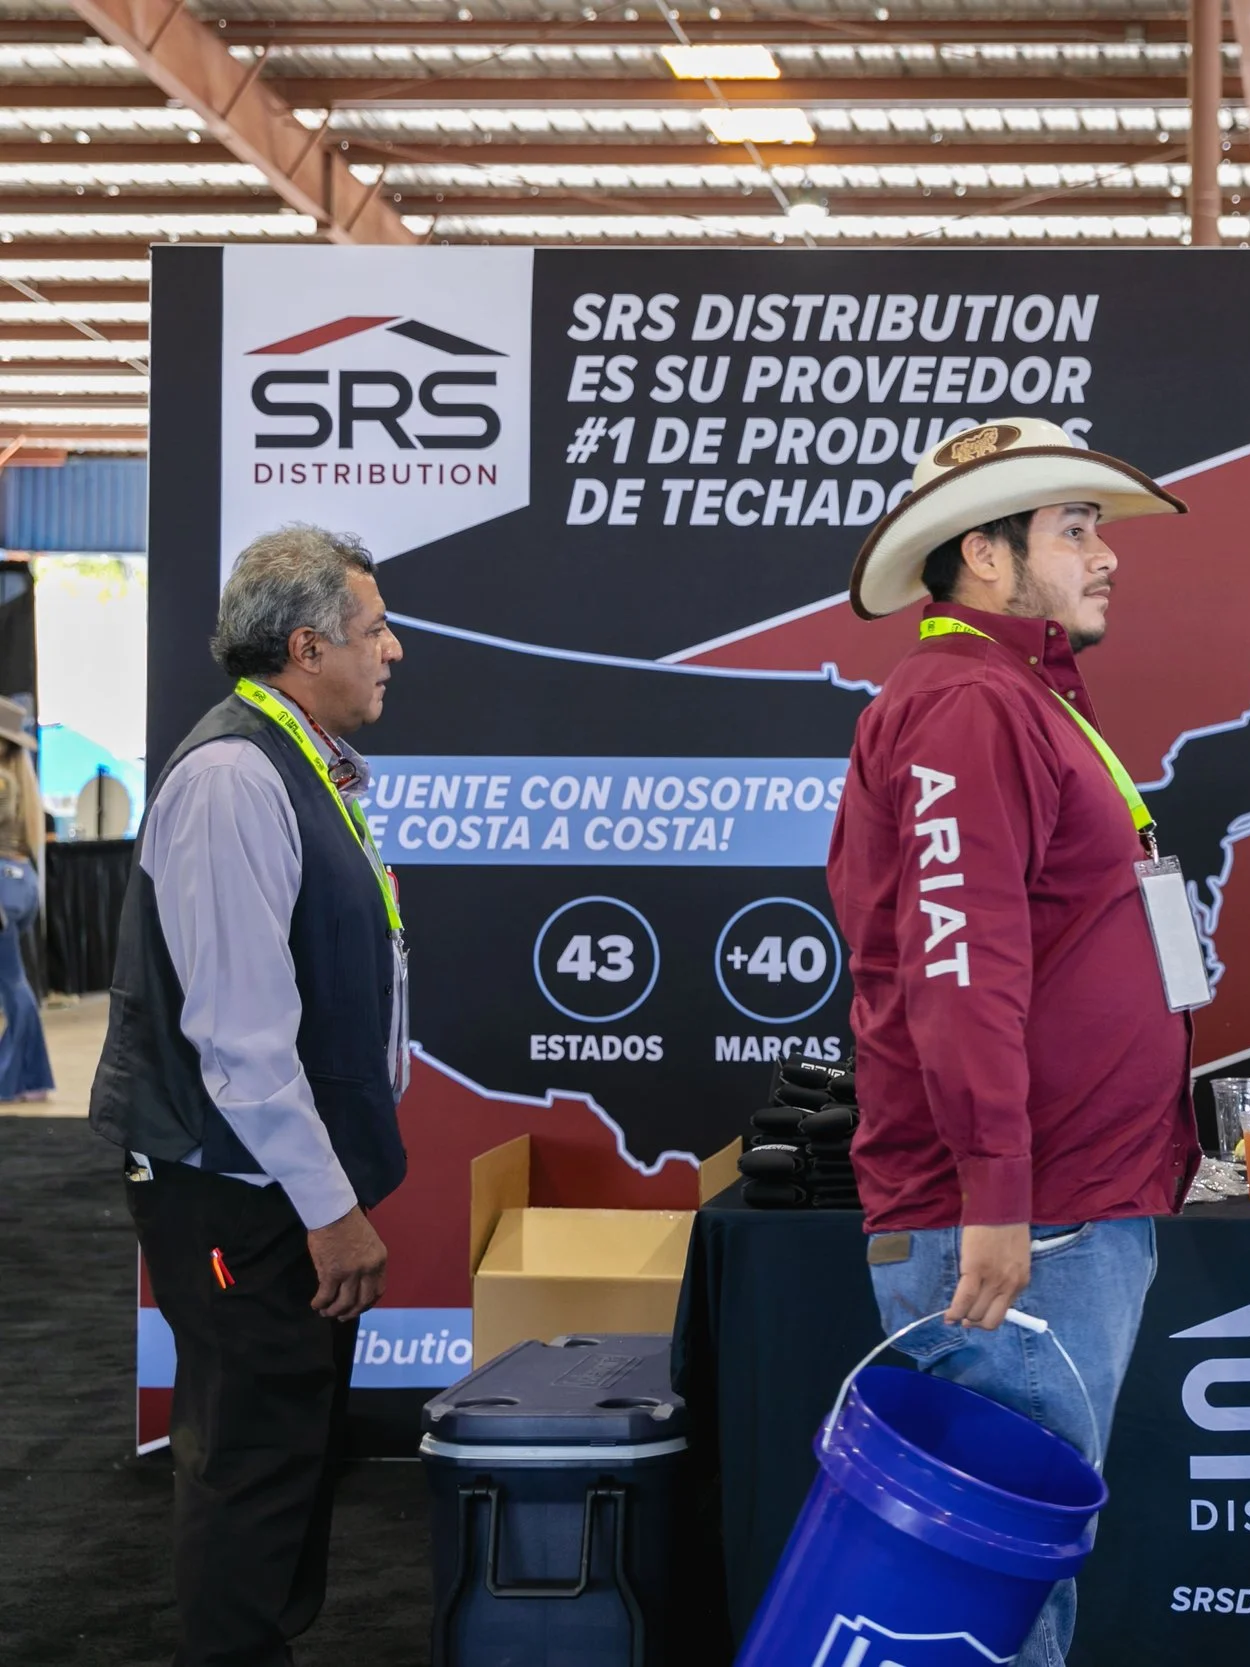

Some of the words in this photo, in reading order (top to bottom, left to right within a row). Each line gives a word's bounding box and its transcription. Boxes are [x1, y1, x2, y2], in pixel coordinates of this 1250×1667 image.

[567, 293, 680, 342] SRS
[691, 294, 1099, 343] DISTRIBUTION
[567, 355, 638, 403] ES
[650, 355, 730, 403] SU
[742, 356, 1092, 404] PROVEEDOR
[250, 370, 501, 450] SRS
[566, 417, 637, 464] #1
[648, 417, 726, 464] DE
[737, 417, 1093, 465] PRODUS
[254, 463, 497, 485] DISTRIBUTION
[566, 479, 645, 526] DE
[521, 775, 618, 810] CON
[625, 776, 847, 811] NOSOTROS
[367, 815, 389, 849] E
[398, 815, 531, 850] COSTA
[541, 817, 570, 850] A
[583, 817, 735, 851] COSTA!
[911, 764, 970, 986] ARIAT
[556, 935, 634, 981] 43
[726, 936, 827, 982] +40
[530, 1034, 664, 1061] ESTADOS
[715, 1036, 841, 1062] MARCAS
[353, 1329, 473, 1365] ibutio
